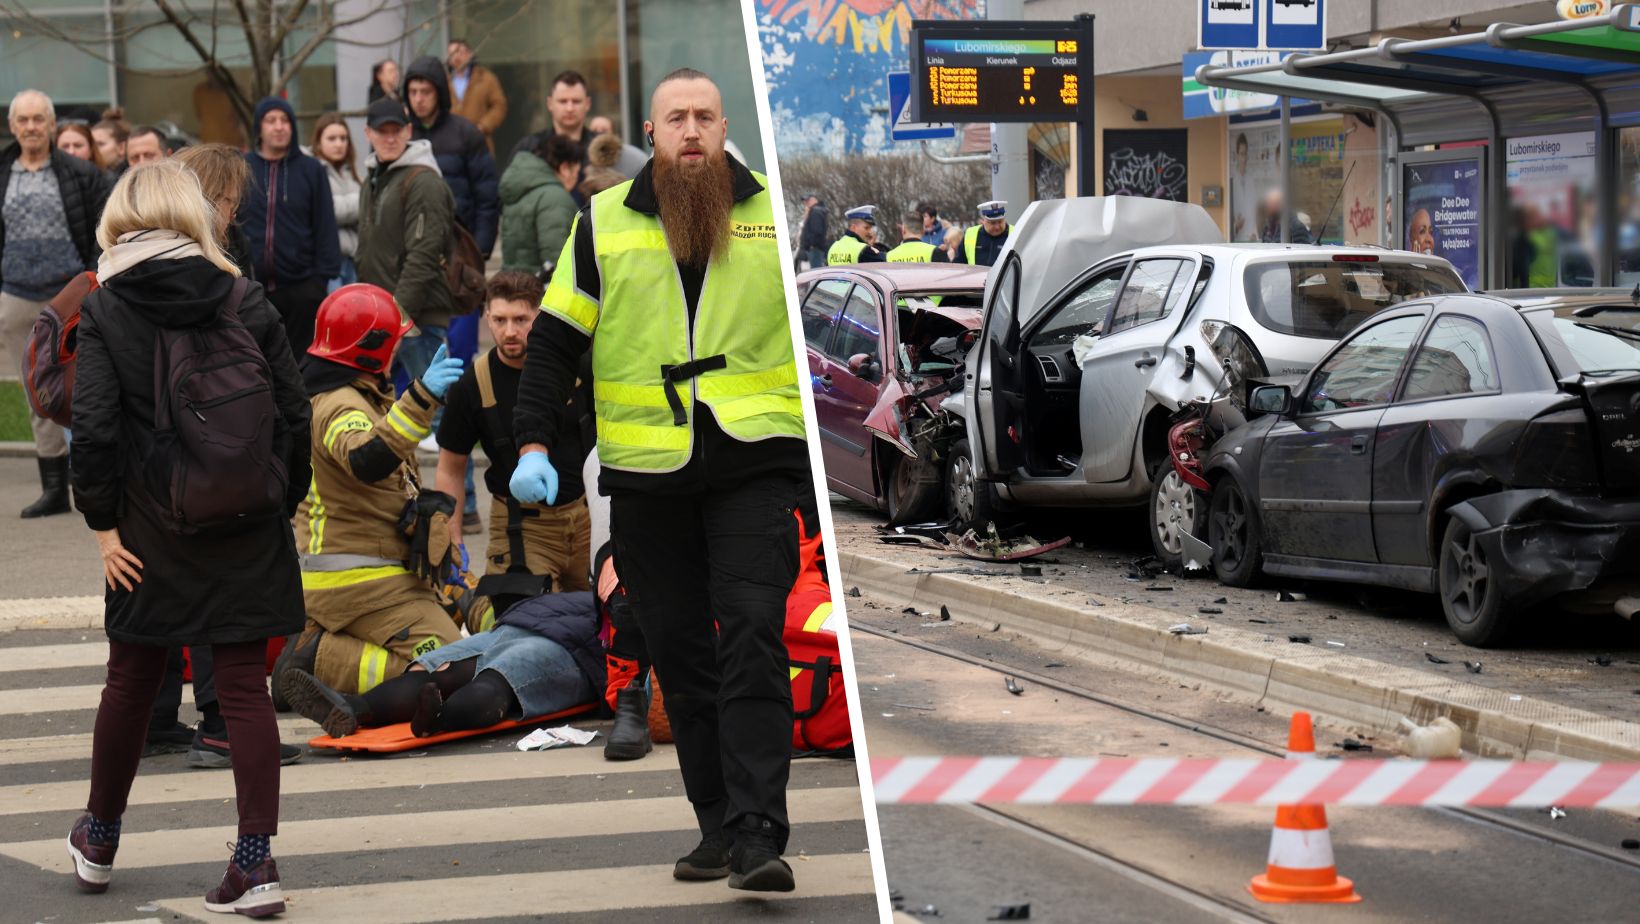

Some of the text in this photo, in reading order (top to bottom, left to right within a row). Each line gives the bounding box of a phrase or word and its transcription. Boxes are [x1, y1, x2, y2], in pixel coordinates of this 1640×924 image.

[1575, 3, 1597, 15] LOTTO
[954, 41, 1026, 55] Lubomirskiego
[927, 56, 1077, 66] Linia Kierunek Odjazd
[940, 89, 977, 97] Turkusowa
[940, 96, 977, 104] Turkusowa
[1509, 141, 1561, 156] Lubomirskiego
[1442, 196, 1470, 208] Dee Dee
[1434, 209, 1477, 224] Bridgewater
[830, 253, 852, 264] POLICJA
[416, 640, 436, 656] PSP
